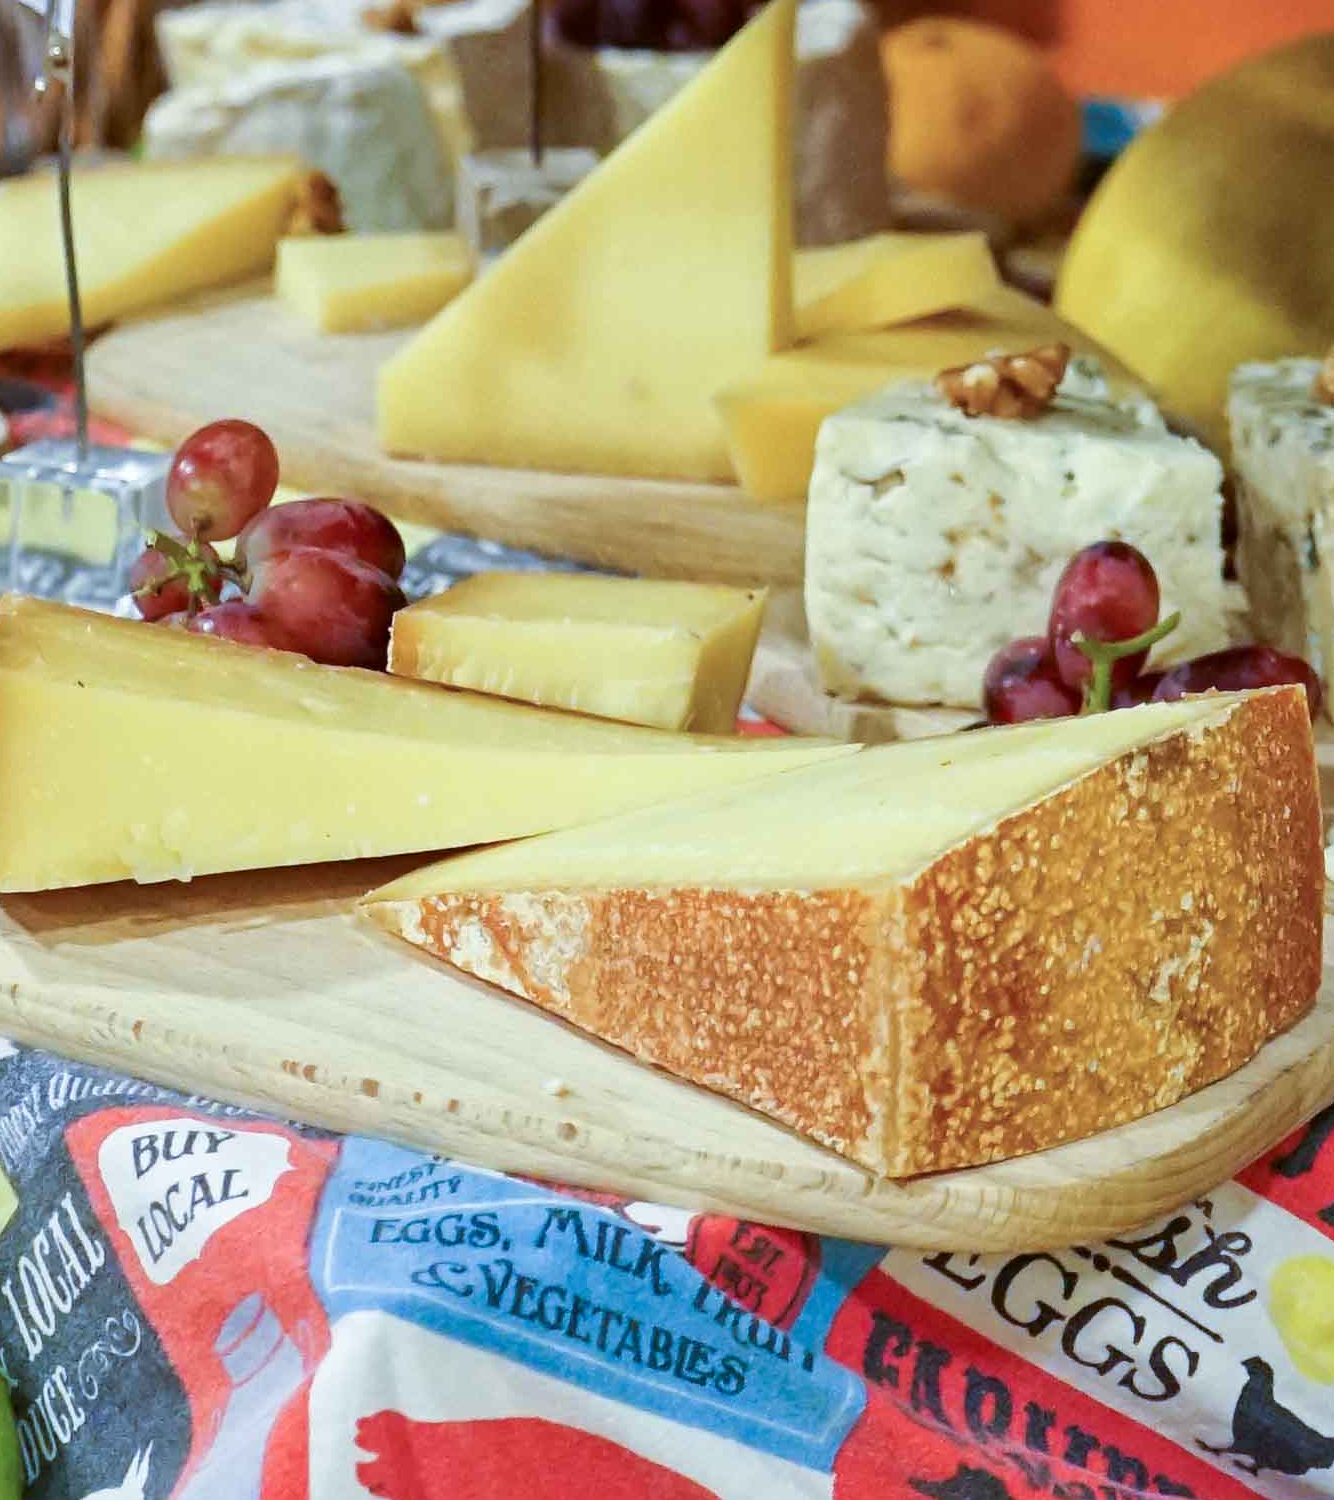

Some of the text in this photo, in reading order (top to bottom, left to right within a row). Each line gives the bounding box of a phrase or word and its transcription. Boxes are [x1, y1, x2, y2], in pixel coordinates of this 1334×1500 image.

[132, 1129, 236, 1180] BUY
[137, 1169, 249, 1264] LOCAL
[2, 1191, 105, 1362] LOCAL
[477, 1257, 748, 1396] VEGETABLES
